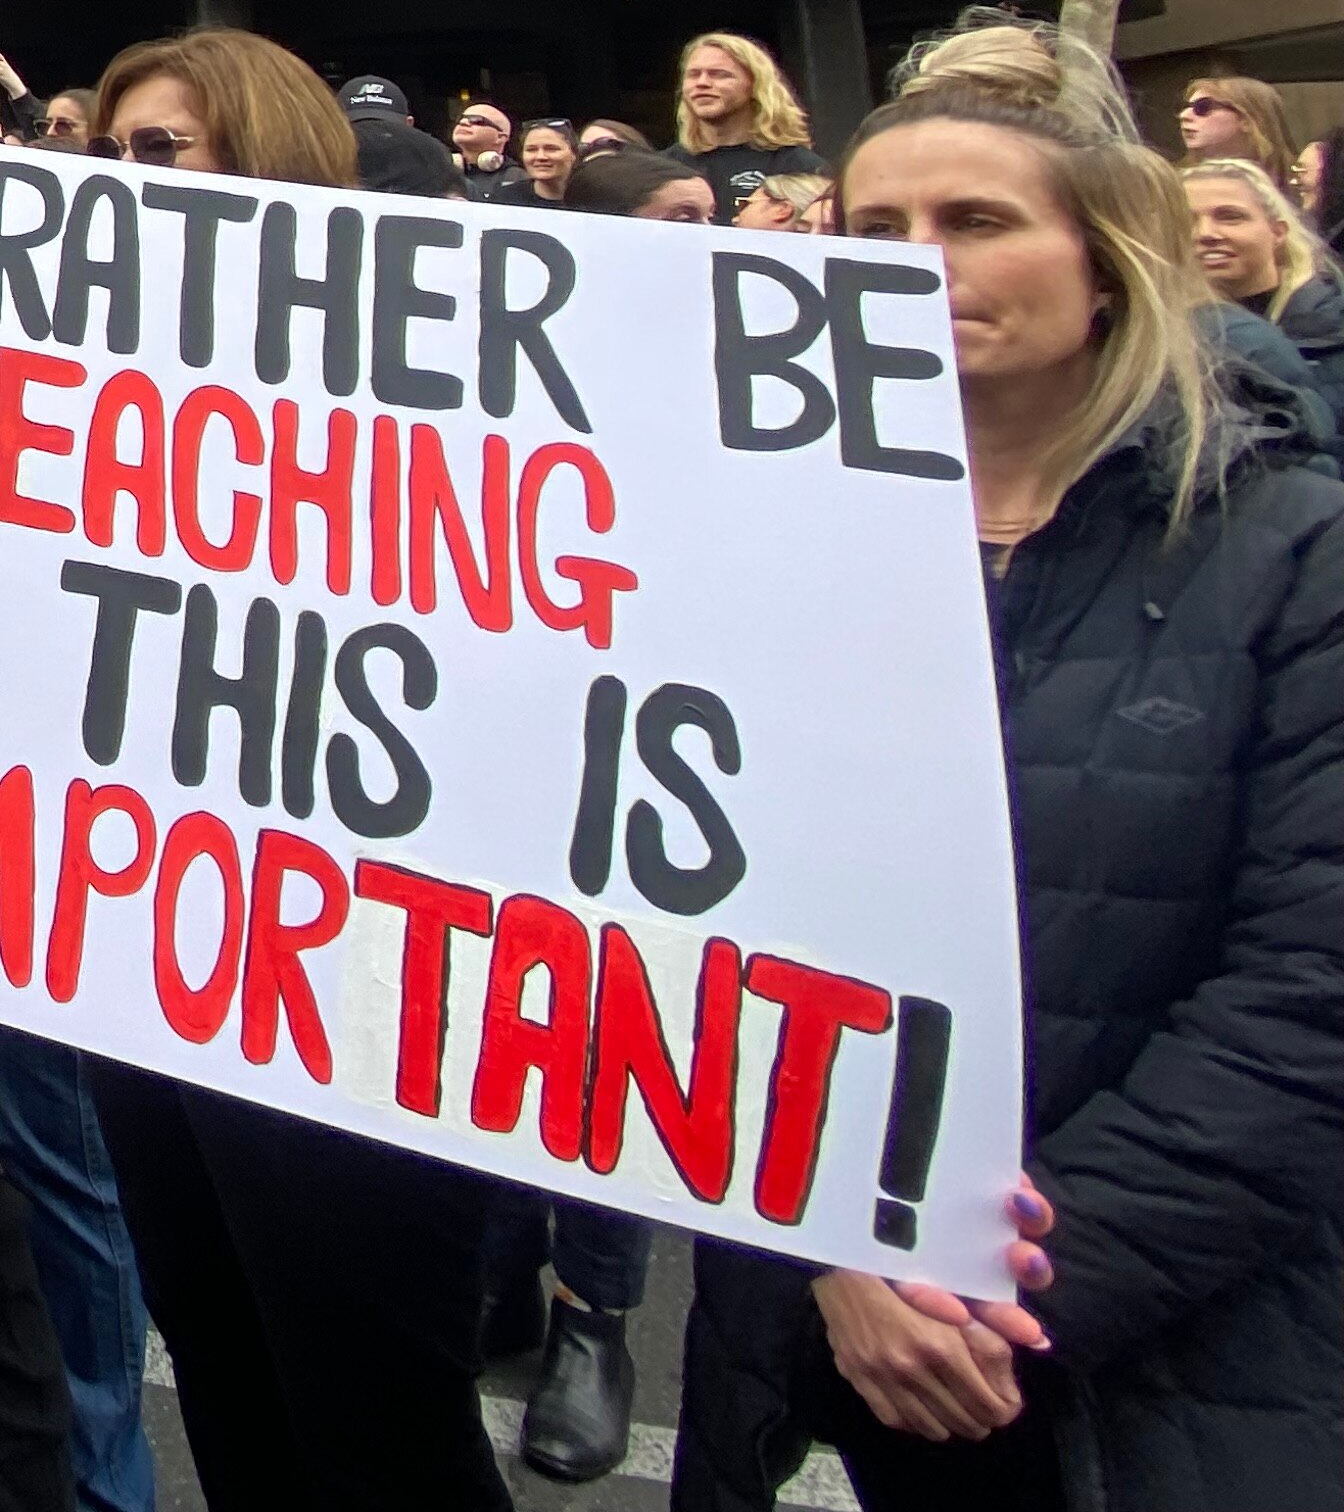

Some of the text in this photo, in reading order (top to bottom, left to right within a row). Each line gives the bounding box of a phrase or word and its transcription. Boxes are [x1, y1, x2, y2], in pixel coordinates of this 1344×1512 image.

[711, 249, 964, 481] BE
[60, 558, 438, 839] THIS
[568, 674, 748, 918] IS
